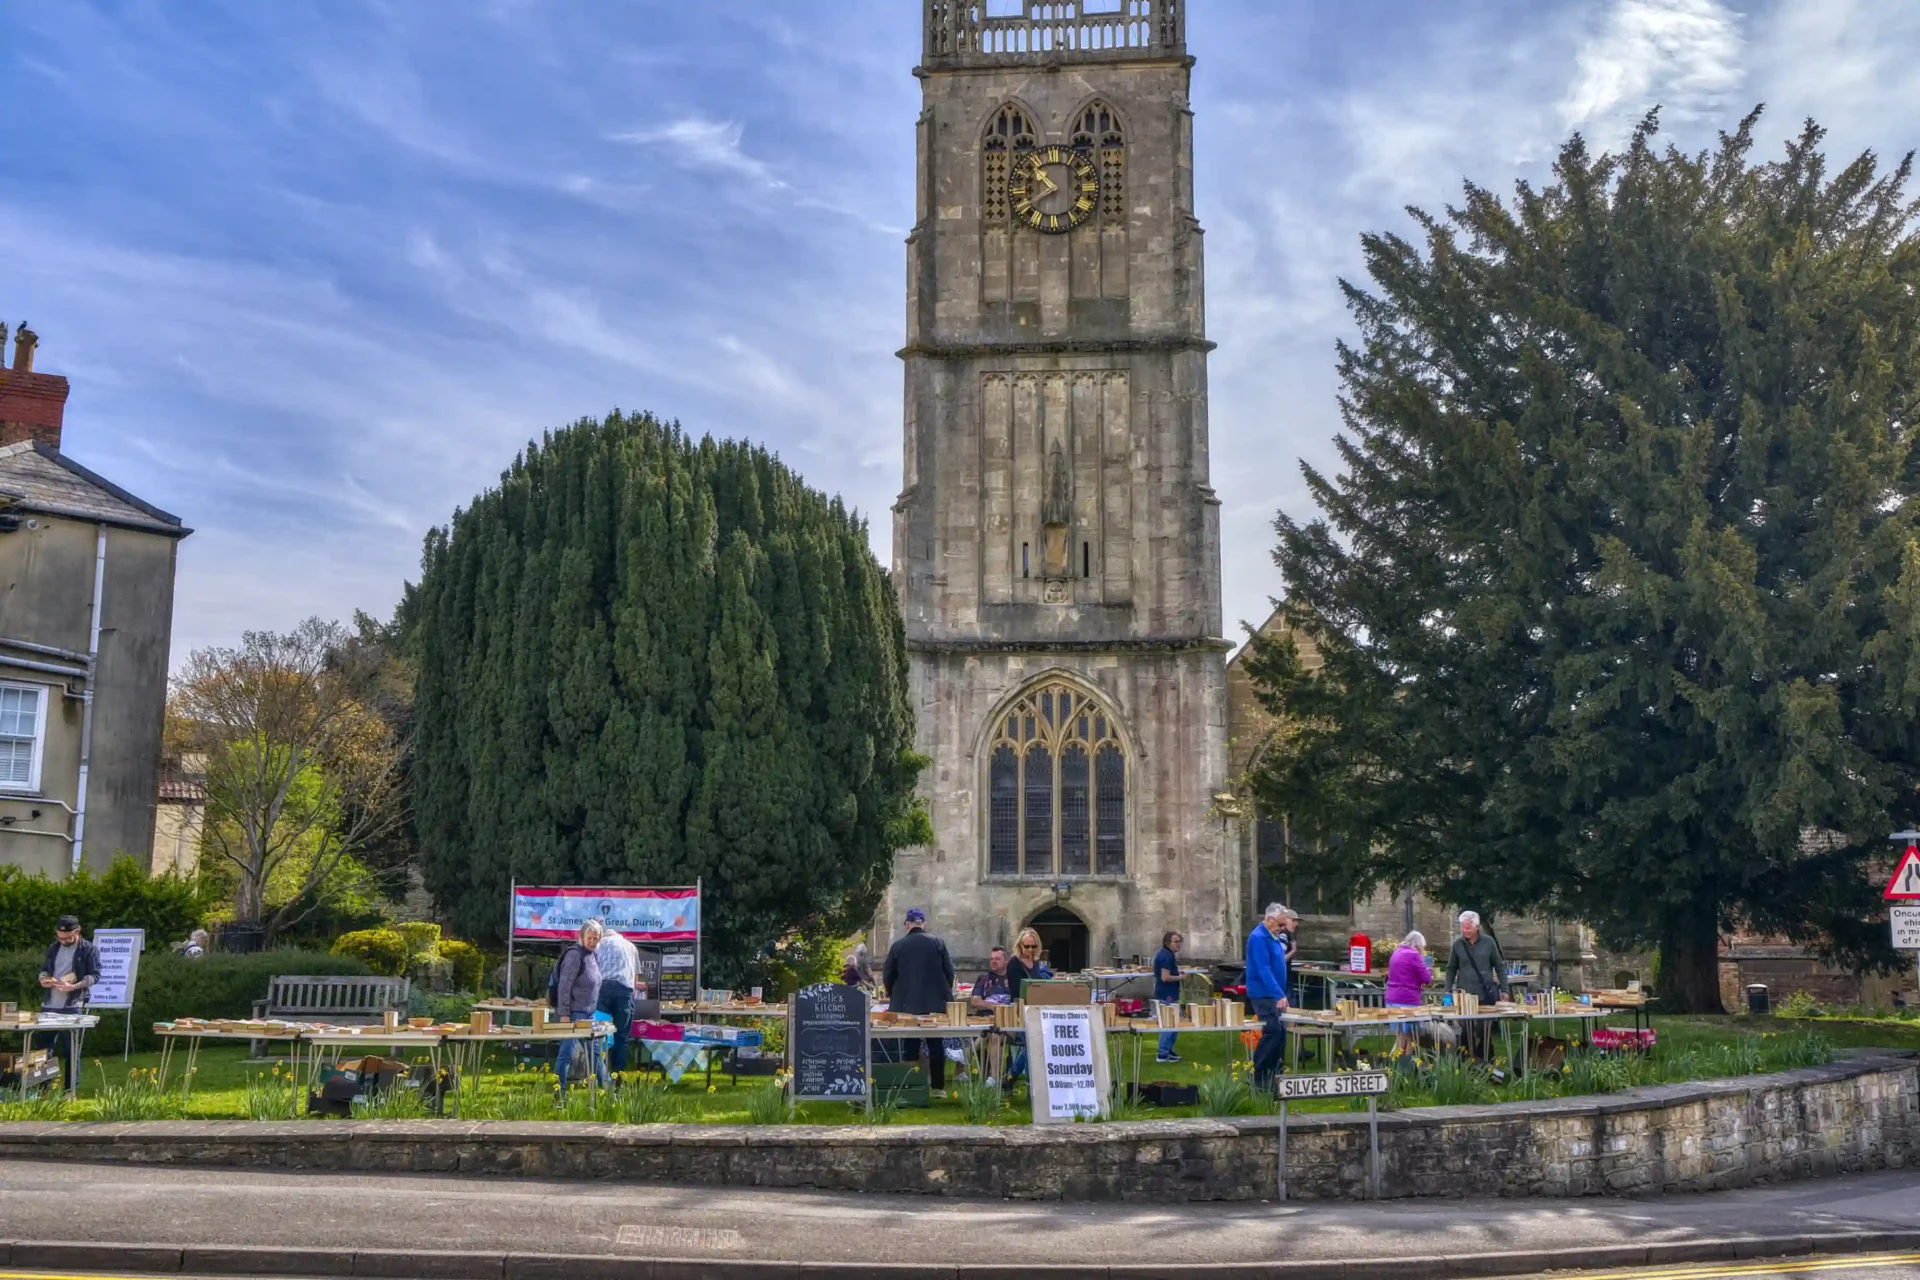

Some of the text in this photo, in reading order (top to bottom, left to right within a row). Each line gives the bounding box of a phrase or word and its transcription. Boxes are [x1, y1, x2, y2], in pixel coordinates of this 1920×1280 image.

[548, 916, 556, 924] St
[558, 917, 584, 925] James
[632, 918, 664, 928] Dursley
[817, 992, 844, 1002] Belle's
[814, 1002, 846, 1012] Kitchen
[1054, 1025, 1079, 1038] FREE
[1051, 1044, 1086, 1056] BOOKS
[1048, 1062, 1092, 1076] Saturday
[1285, 1076, 1382, 1096] SILVER STREET
